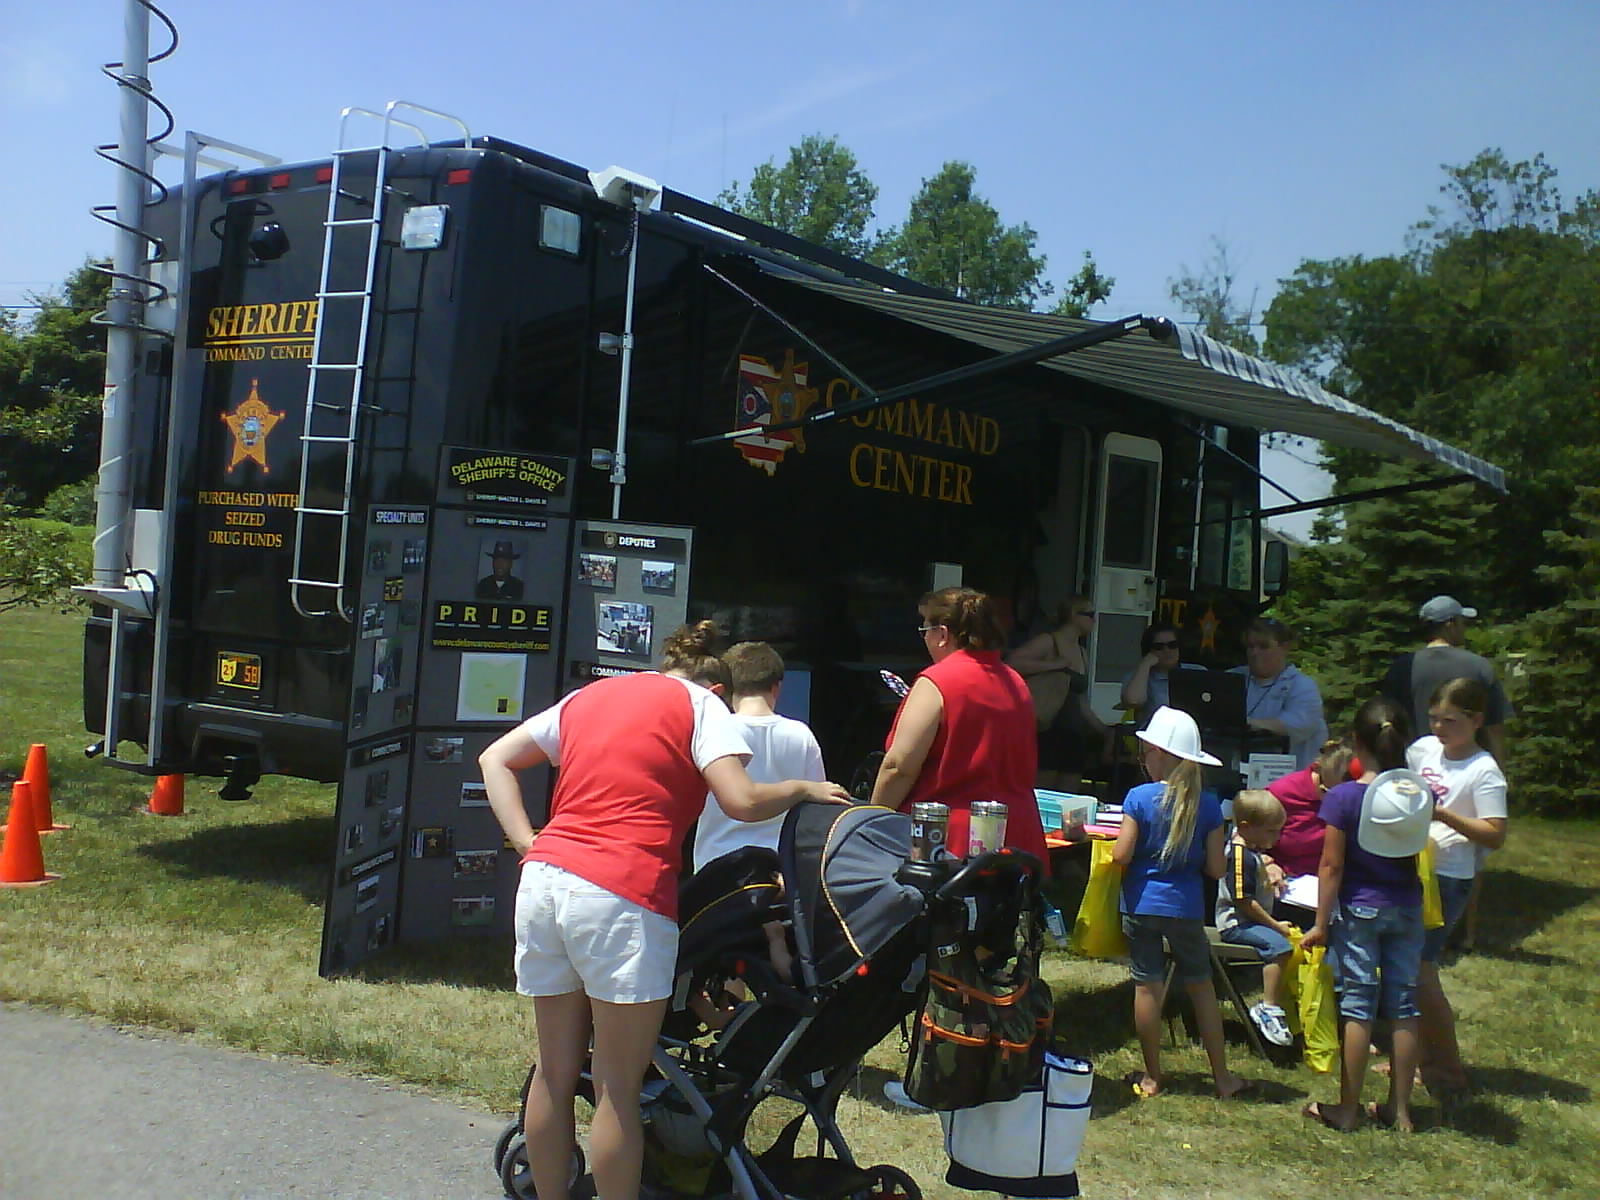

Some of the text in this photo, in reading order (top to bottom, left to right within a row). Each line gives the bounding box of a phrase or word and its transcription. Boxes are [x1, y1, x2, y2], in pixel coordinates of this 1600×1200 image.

[206, 301, 319, 337] SHERIFF
[270, 344, 313, 359] CENTE
[451, 456, 566, 483] DELAWARE COUNTY
[849, 443, 974, 505] CENTER
[458, 467, 556, 492] SHERIFF'S OFFICE
[198, 491, 300, 508] PURCHASED WITH
[224, 511, 266, 527] SEIZED
[208, 531, 282, 548] DRUG FUNDS
[618, 536, 657, 549] DEPUTIES
